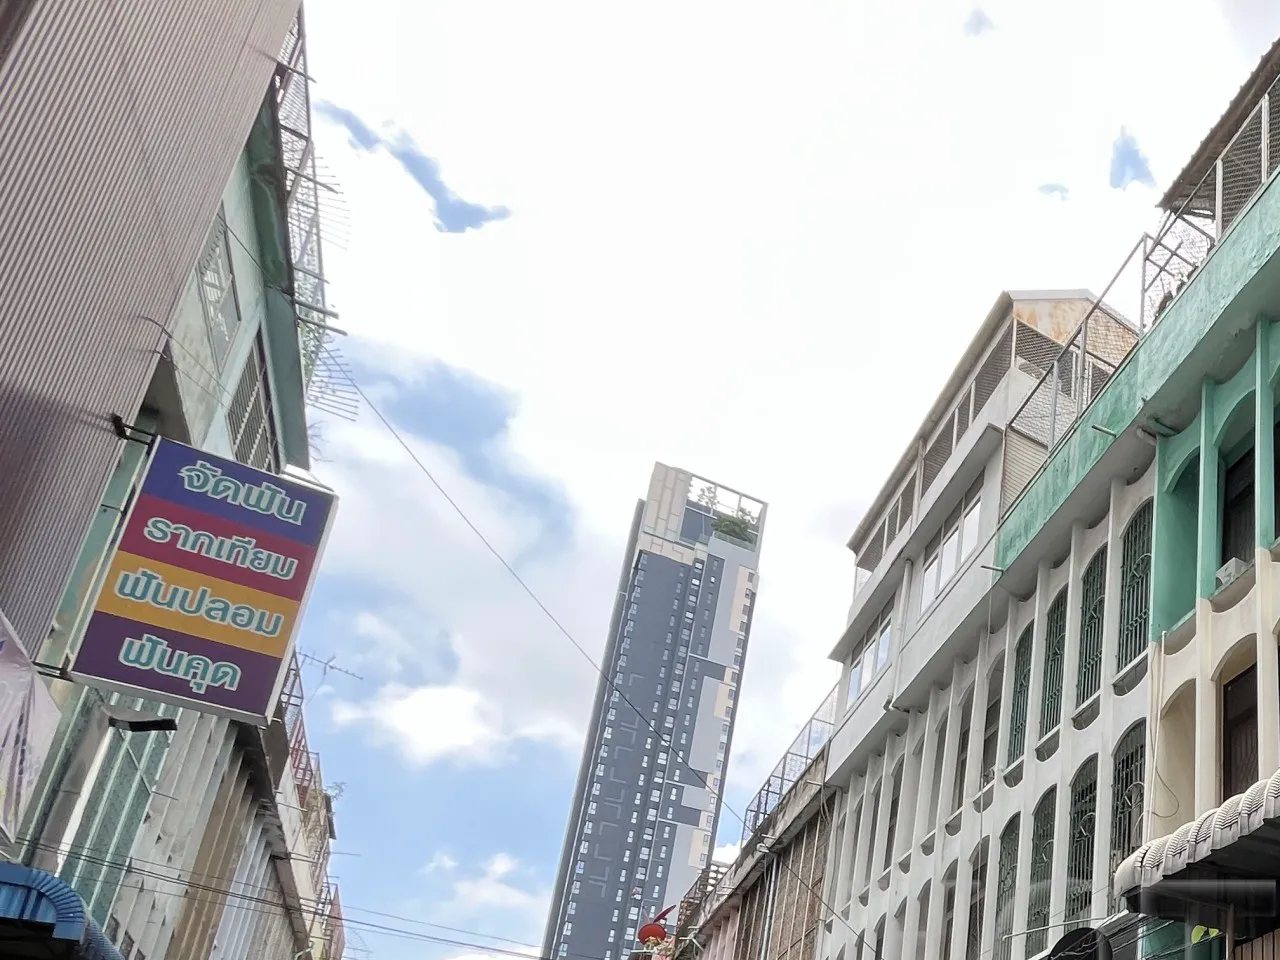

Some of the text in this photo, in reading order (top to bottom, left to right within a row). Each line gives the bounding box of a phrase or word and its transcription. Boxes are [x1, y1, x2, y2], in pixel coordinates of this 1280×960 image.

[179, 461, 306, 526] จัดฟัน
[144, 516, 298, 581] รากเทียม
[115, 569, 285, 638] ฟันปลอม
[119, 634, 243, 696] ฟันคุด
